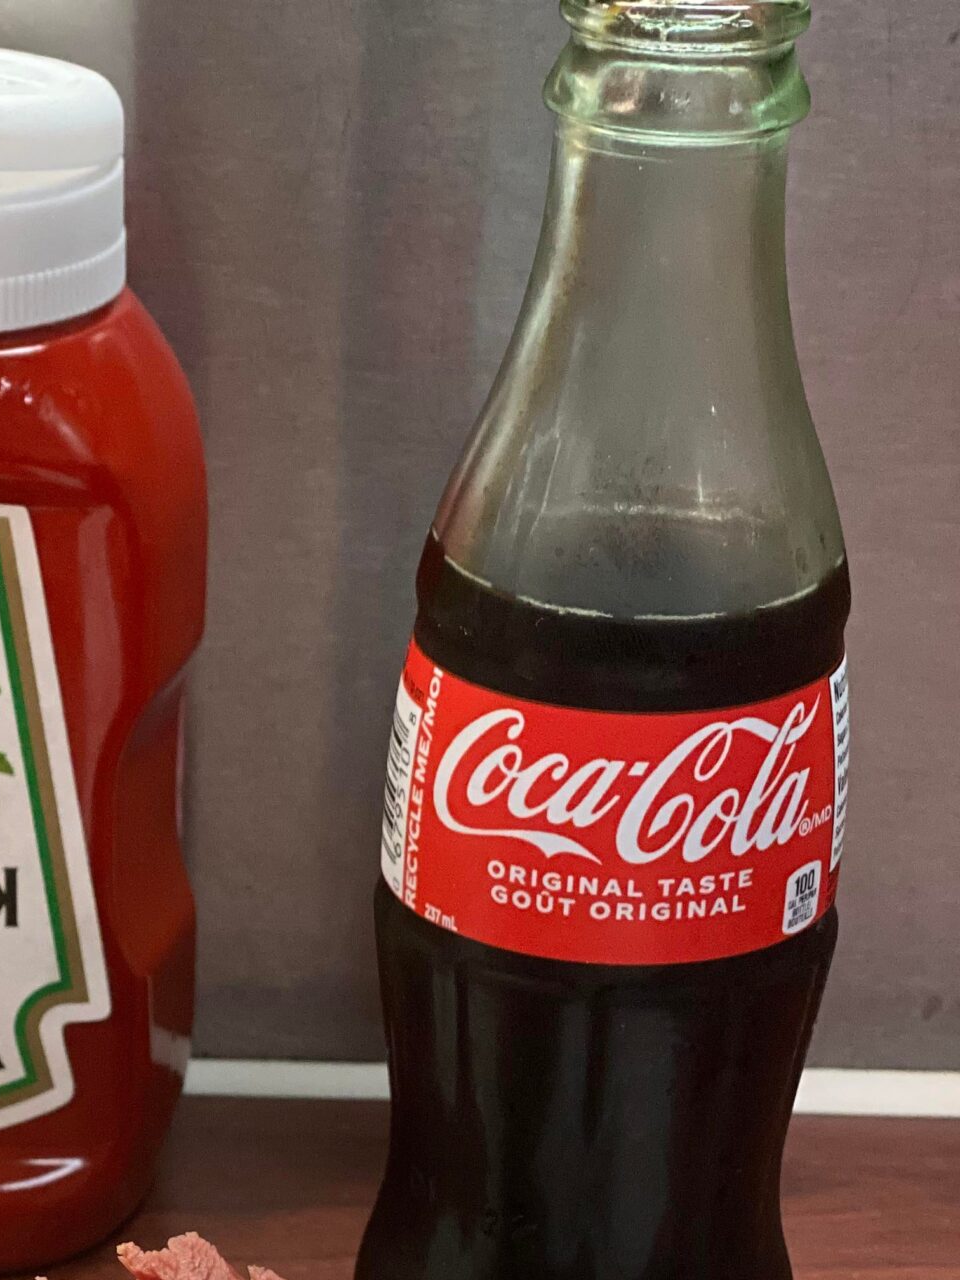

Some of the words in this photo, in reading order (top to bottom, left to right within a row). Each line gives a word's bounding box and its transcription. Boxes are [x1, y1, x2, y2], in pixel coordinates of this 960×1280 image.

[433, 692, 821, 865] Coca-Cola
[404, 788, 423, 910] RECYCLE
[487, 859, 642, 898] ORIGINAL
[658, 868, 753, 897] TASTE
[795, 869, 815, 898] 100
[490, 885, 575, 917] GOÛT
[589, 895, 746, 921] ORIGINAL
